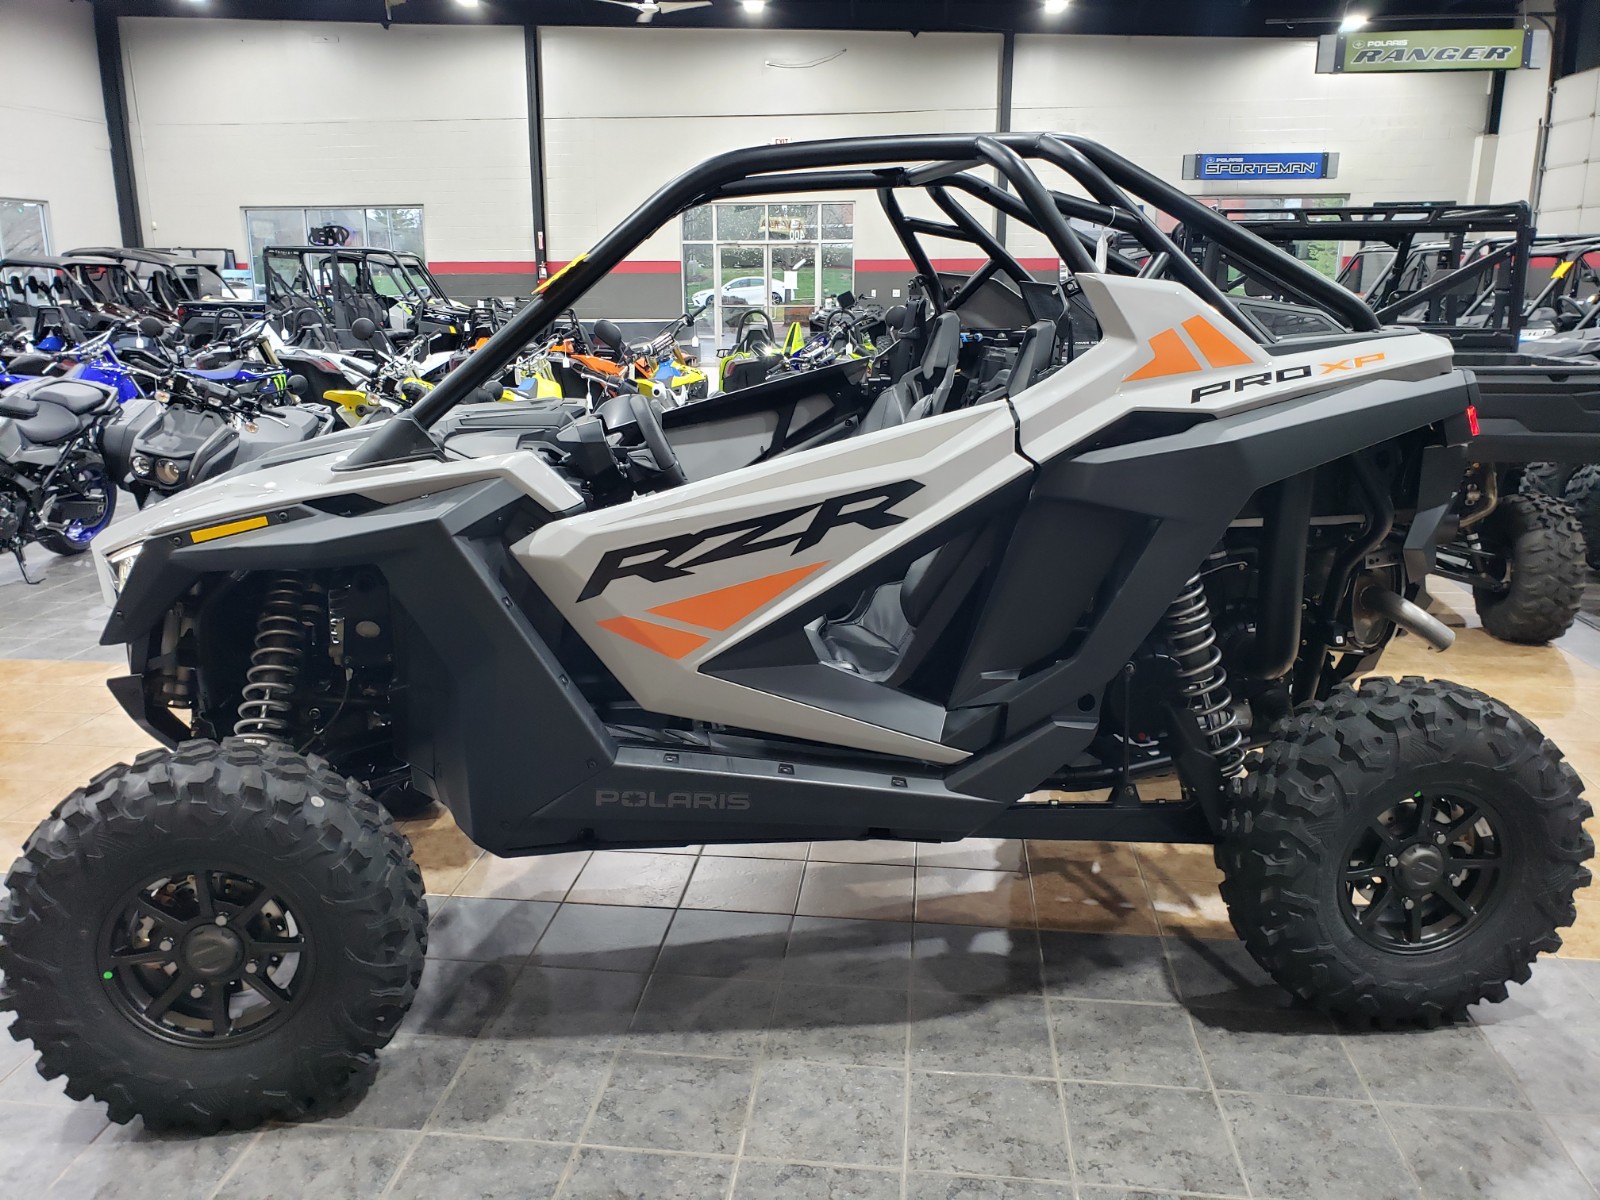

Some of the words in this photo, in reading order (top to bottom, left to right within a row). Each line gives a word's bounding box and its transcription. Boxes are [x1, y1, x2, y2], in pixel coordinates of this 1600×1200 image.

[1367, 39, 1408, 47] POLARIS
[1351, 46, 1514, 64] RANGER
[1205, 162, 1316, 175] SPORTSMAN
[1191, 365, 1312, 404] PRO
[1318, 352, 1385, 375] XP
[575, 479, 926, 604] RZR
[595, 790, 751, 810] POLARIS
